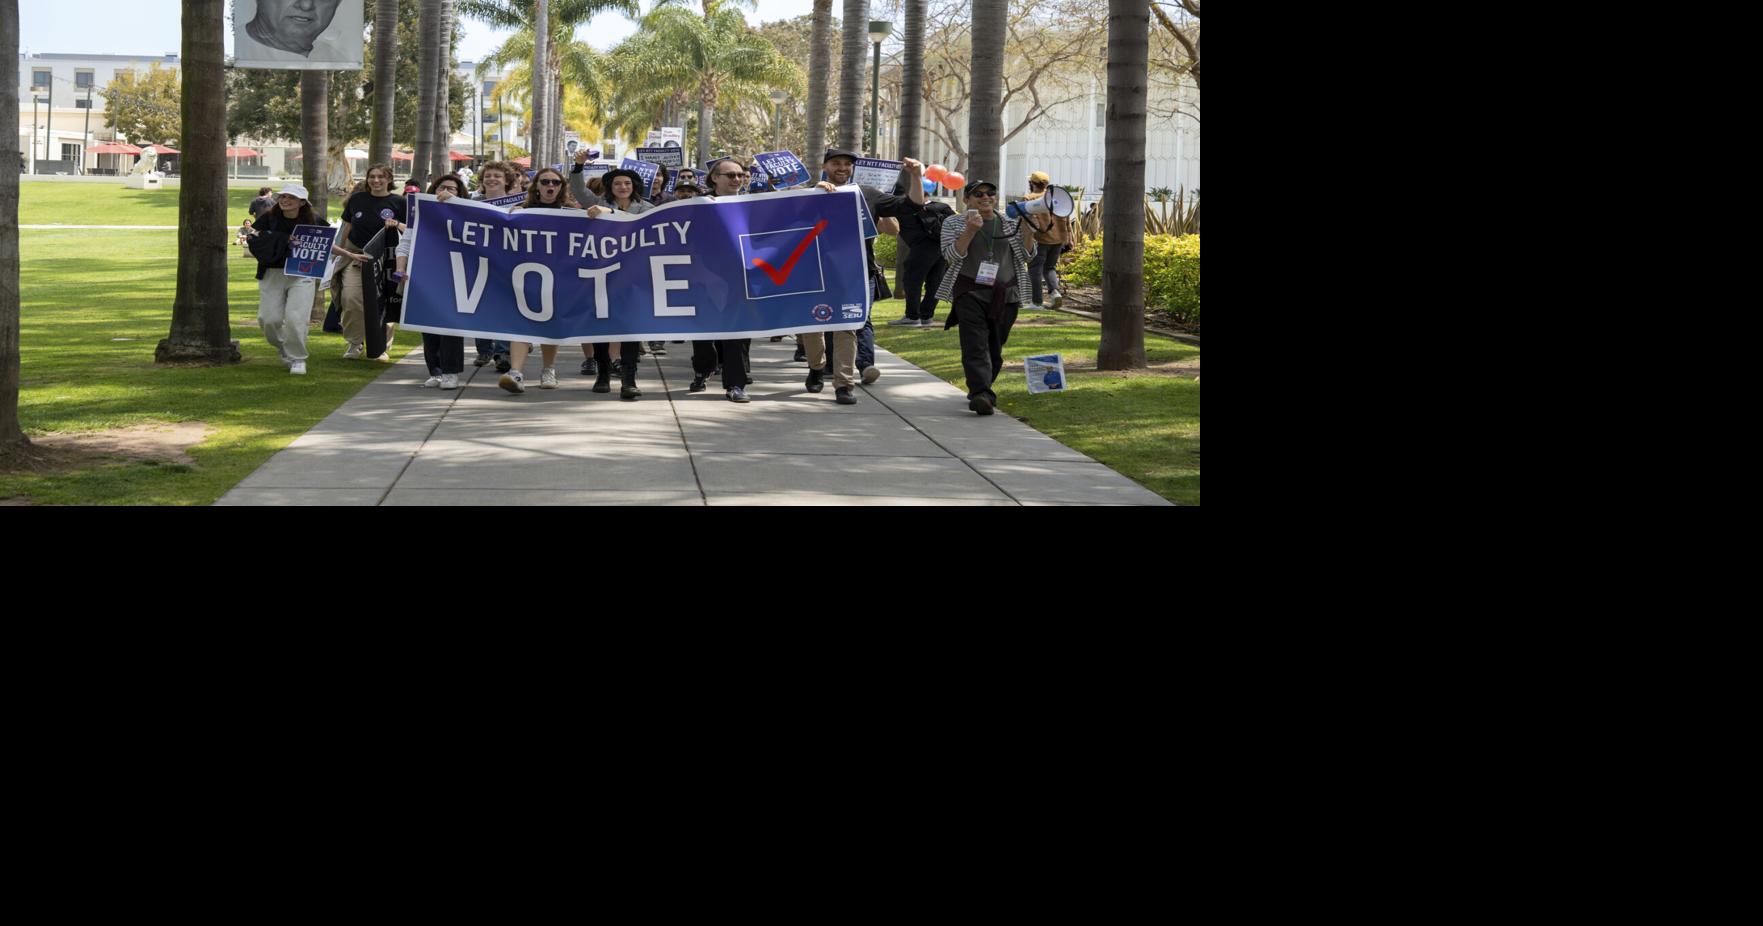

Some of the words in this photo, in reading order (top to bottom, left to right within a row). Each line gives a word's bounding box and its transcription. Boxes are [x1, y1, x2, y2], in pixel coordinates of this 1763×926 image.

[769, 161, 801, 178] VOTE
[503, 195, 524, 205] FACULTY
[313, 236, 330, 244] NTT
[447, 219, 494, 248] LET
[503, 227, 558, 255] NTT
[568, 220, 692, 260] FACULTY
[292, 248, 326, 261] VOTE
[449, 251, 697, 322] VOTE
